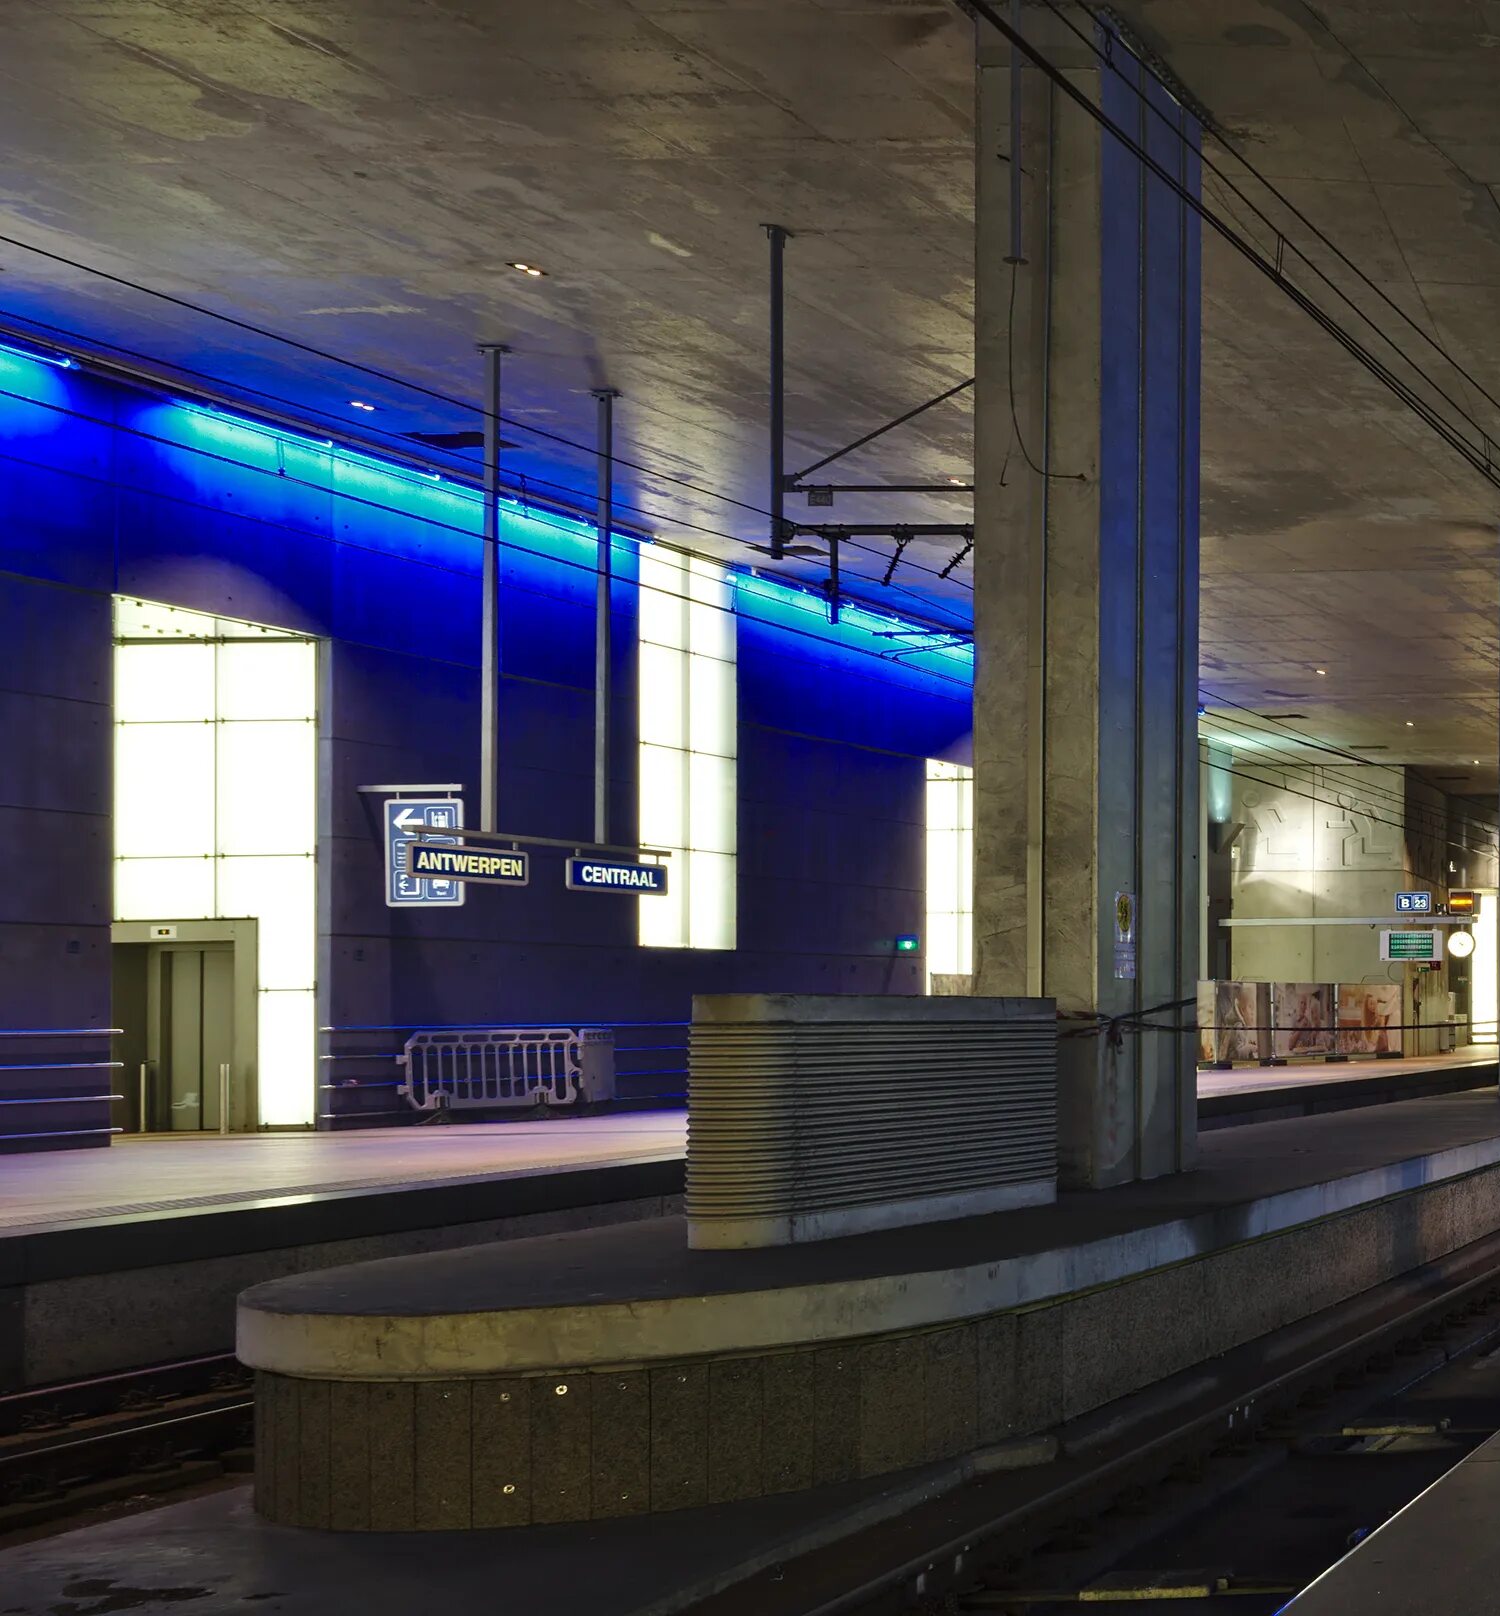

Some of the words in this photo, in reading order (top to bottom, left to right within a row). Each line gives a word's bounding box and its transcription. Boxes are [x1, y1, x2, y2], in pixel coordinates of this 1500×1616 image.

[416, 851, 523, 878] ANTWERPEN
[581, 865, 658, 889] CENTRAAL
[1401, 898, 1410, 908] B
[1414, 899, 1426, 908] 23
